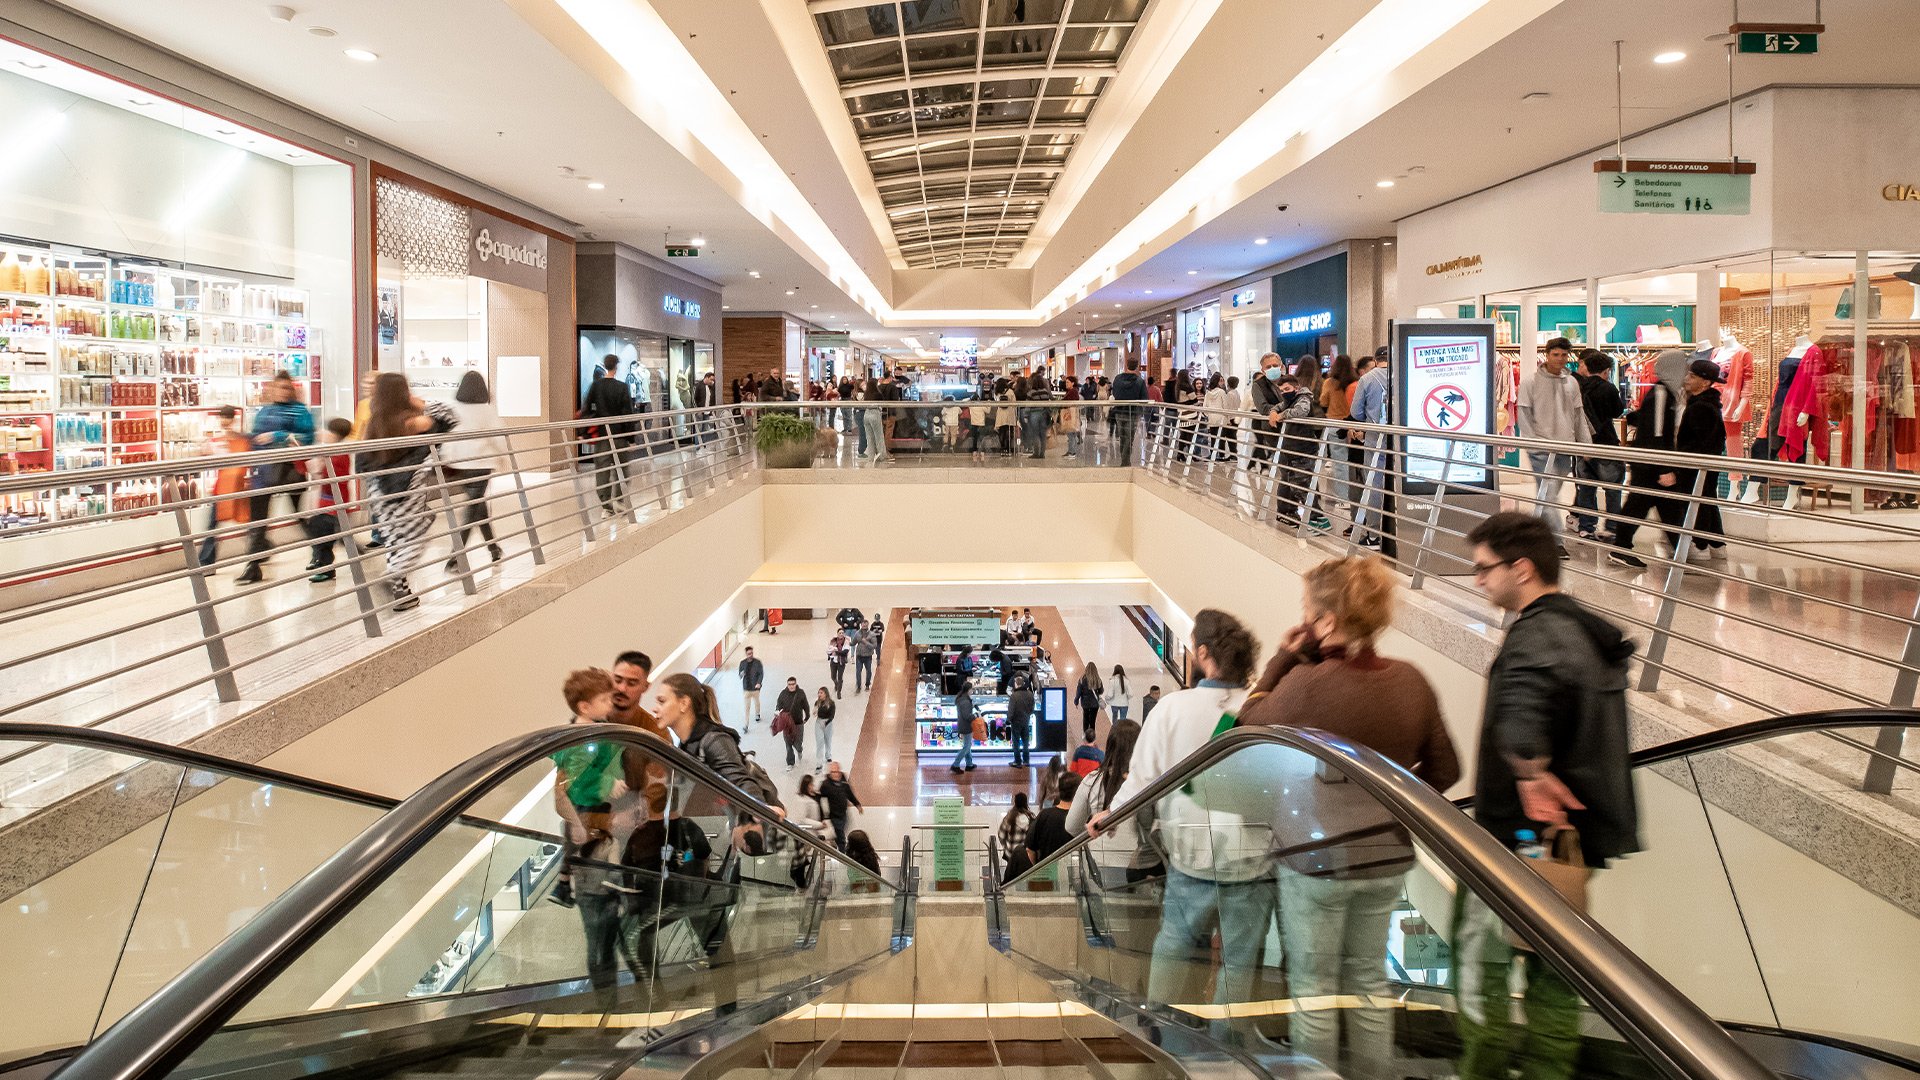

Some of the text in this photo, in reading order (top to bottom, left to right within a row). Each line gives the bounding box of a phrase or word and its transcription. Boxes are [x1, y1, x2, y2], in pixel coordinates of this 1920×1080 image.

[1634, 200, 1675, 208] Sanitários
[493, 241, 547, 270] capodarte
[1279, 319, 1291, 334] THE
[1291, 316, 1310, 333] BODY
